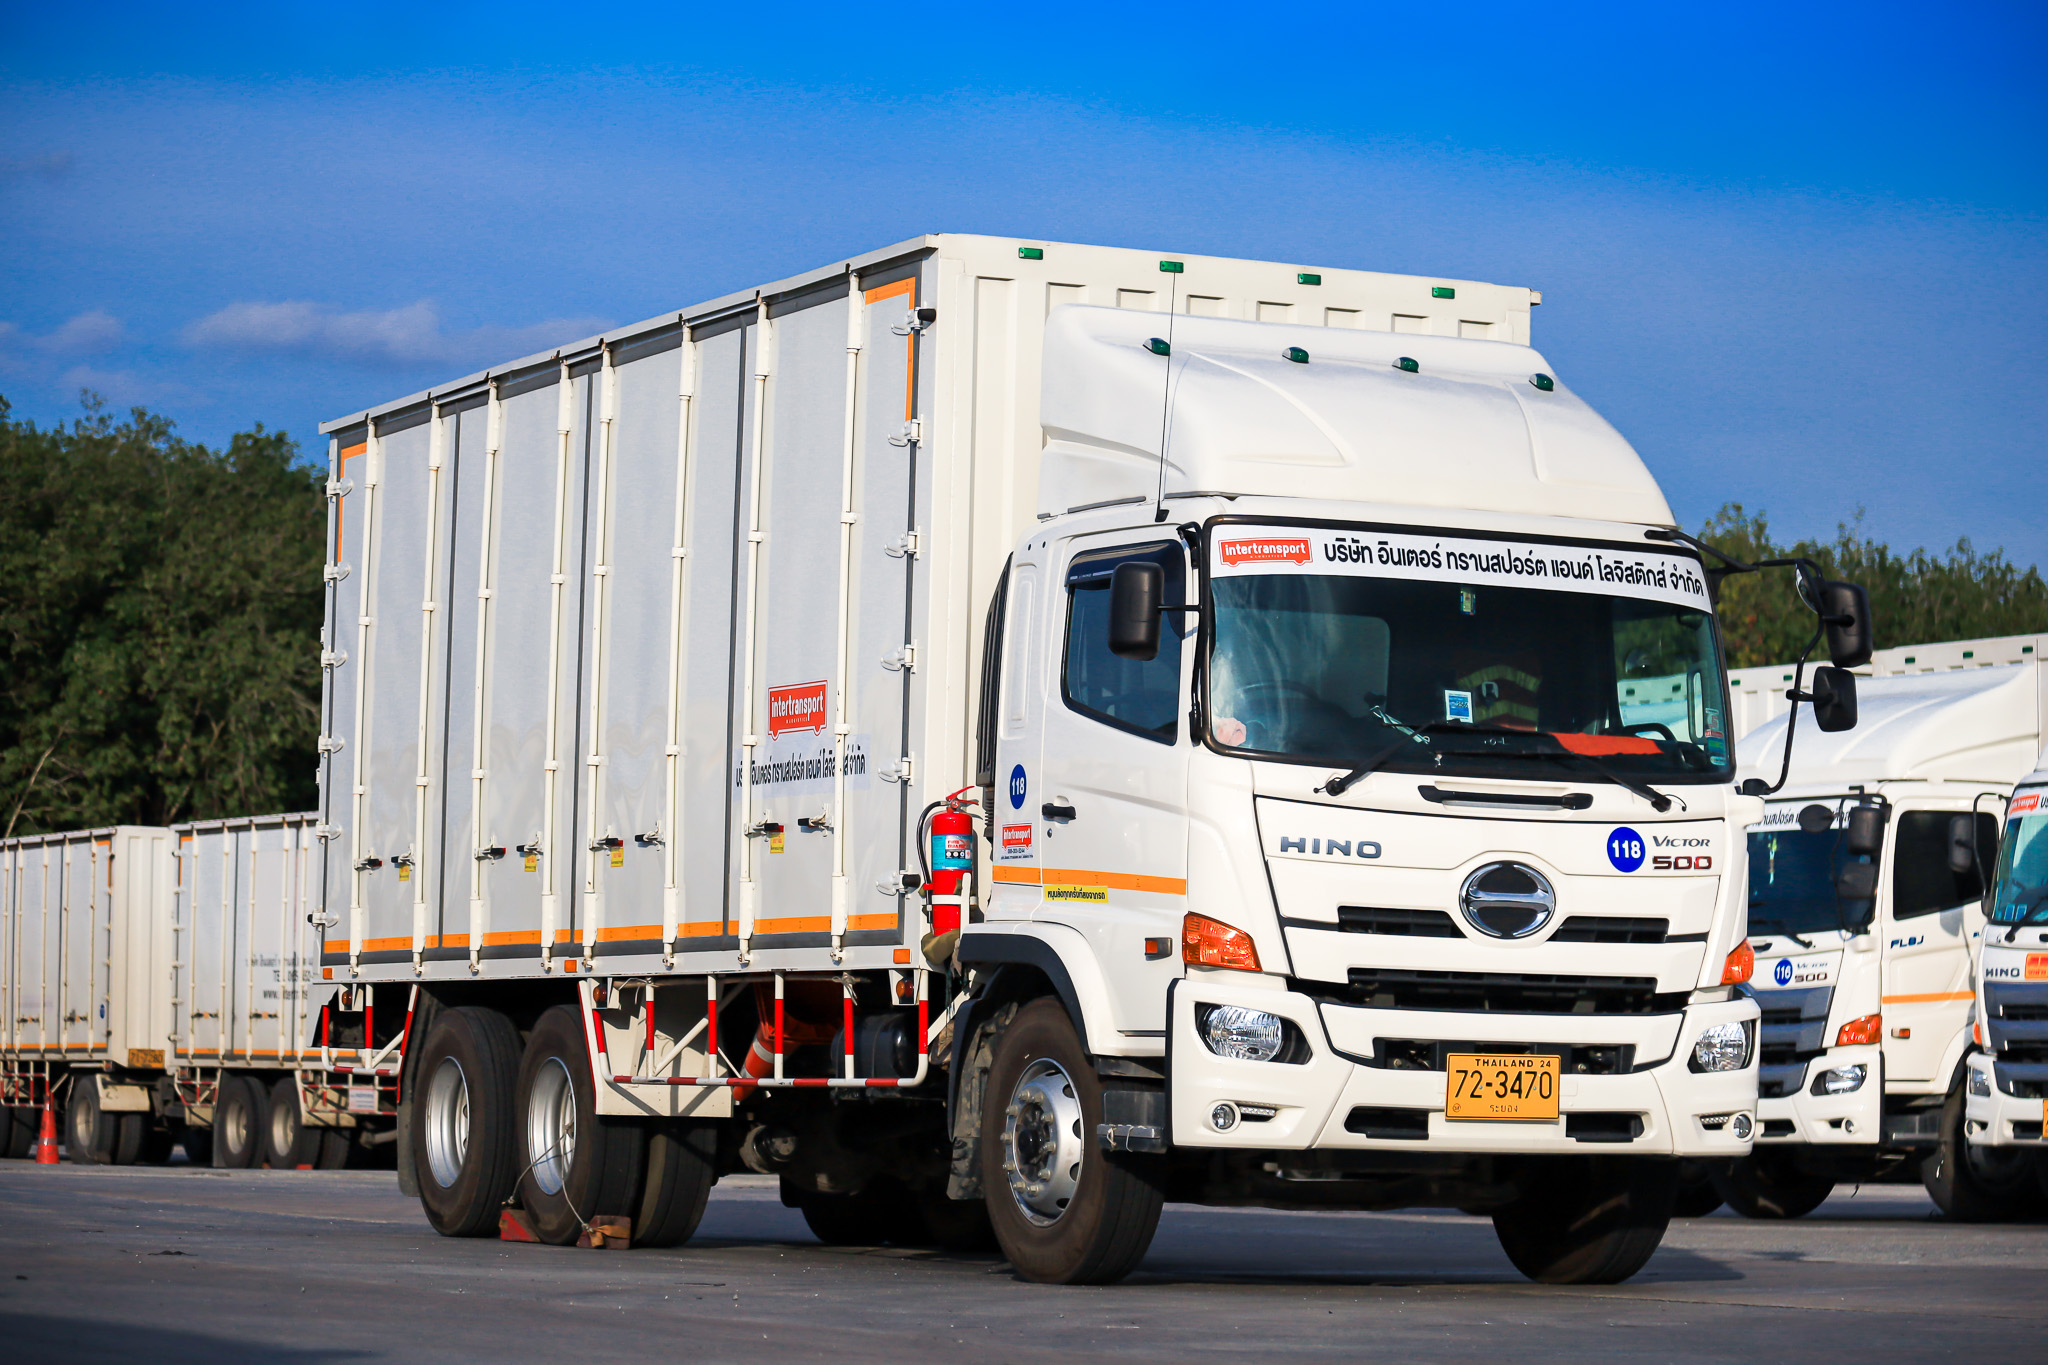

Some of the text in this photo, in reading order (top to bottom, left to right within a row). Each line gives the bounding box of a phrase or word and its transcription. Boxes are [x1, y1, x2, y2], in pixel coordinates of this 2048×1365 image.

[1225, 543, 1306, 557] intertransport
[1324, 537, 1704, 596] บริษัท อินเตอร์ ทรานสปอร์ต แอนด์ โลจิสติกส์ จำกัด
[771, 690, 823, 721] intertransport
[1012, 777, 1025, 796] 118
[1280, 836, 1382, 859] HINO
[1652, 835, 1710, 847] VICTOR
[1612, 839, 1641, 859] 118
[1652, 856, 1712, 870] 500
[1794, 972, 1828, 983] 500
[1985, 967, 2020, 978] HINO
[1475, 1059, 1551, 1068] THAILAND 24
[1455, 1070, 1552, 1099] 72-3470
[1489, 1104, 1518, 1113] ระยอง
